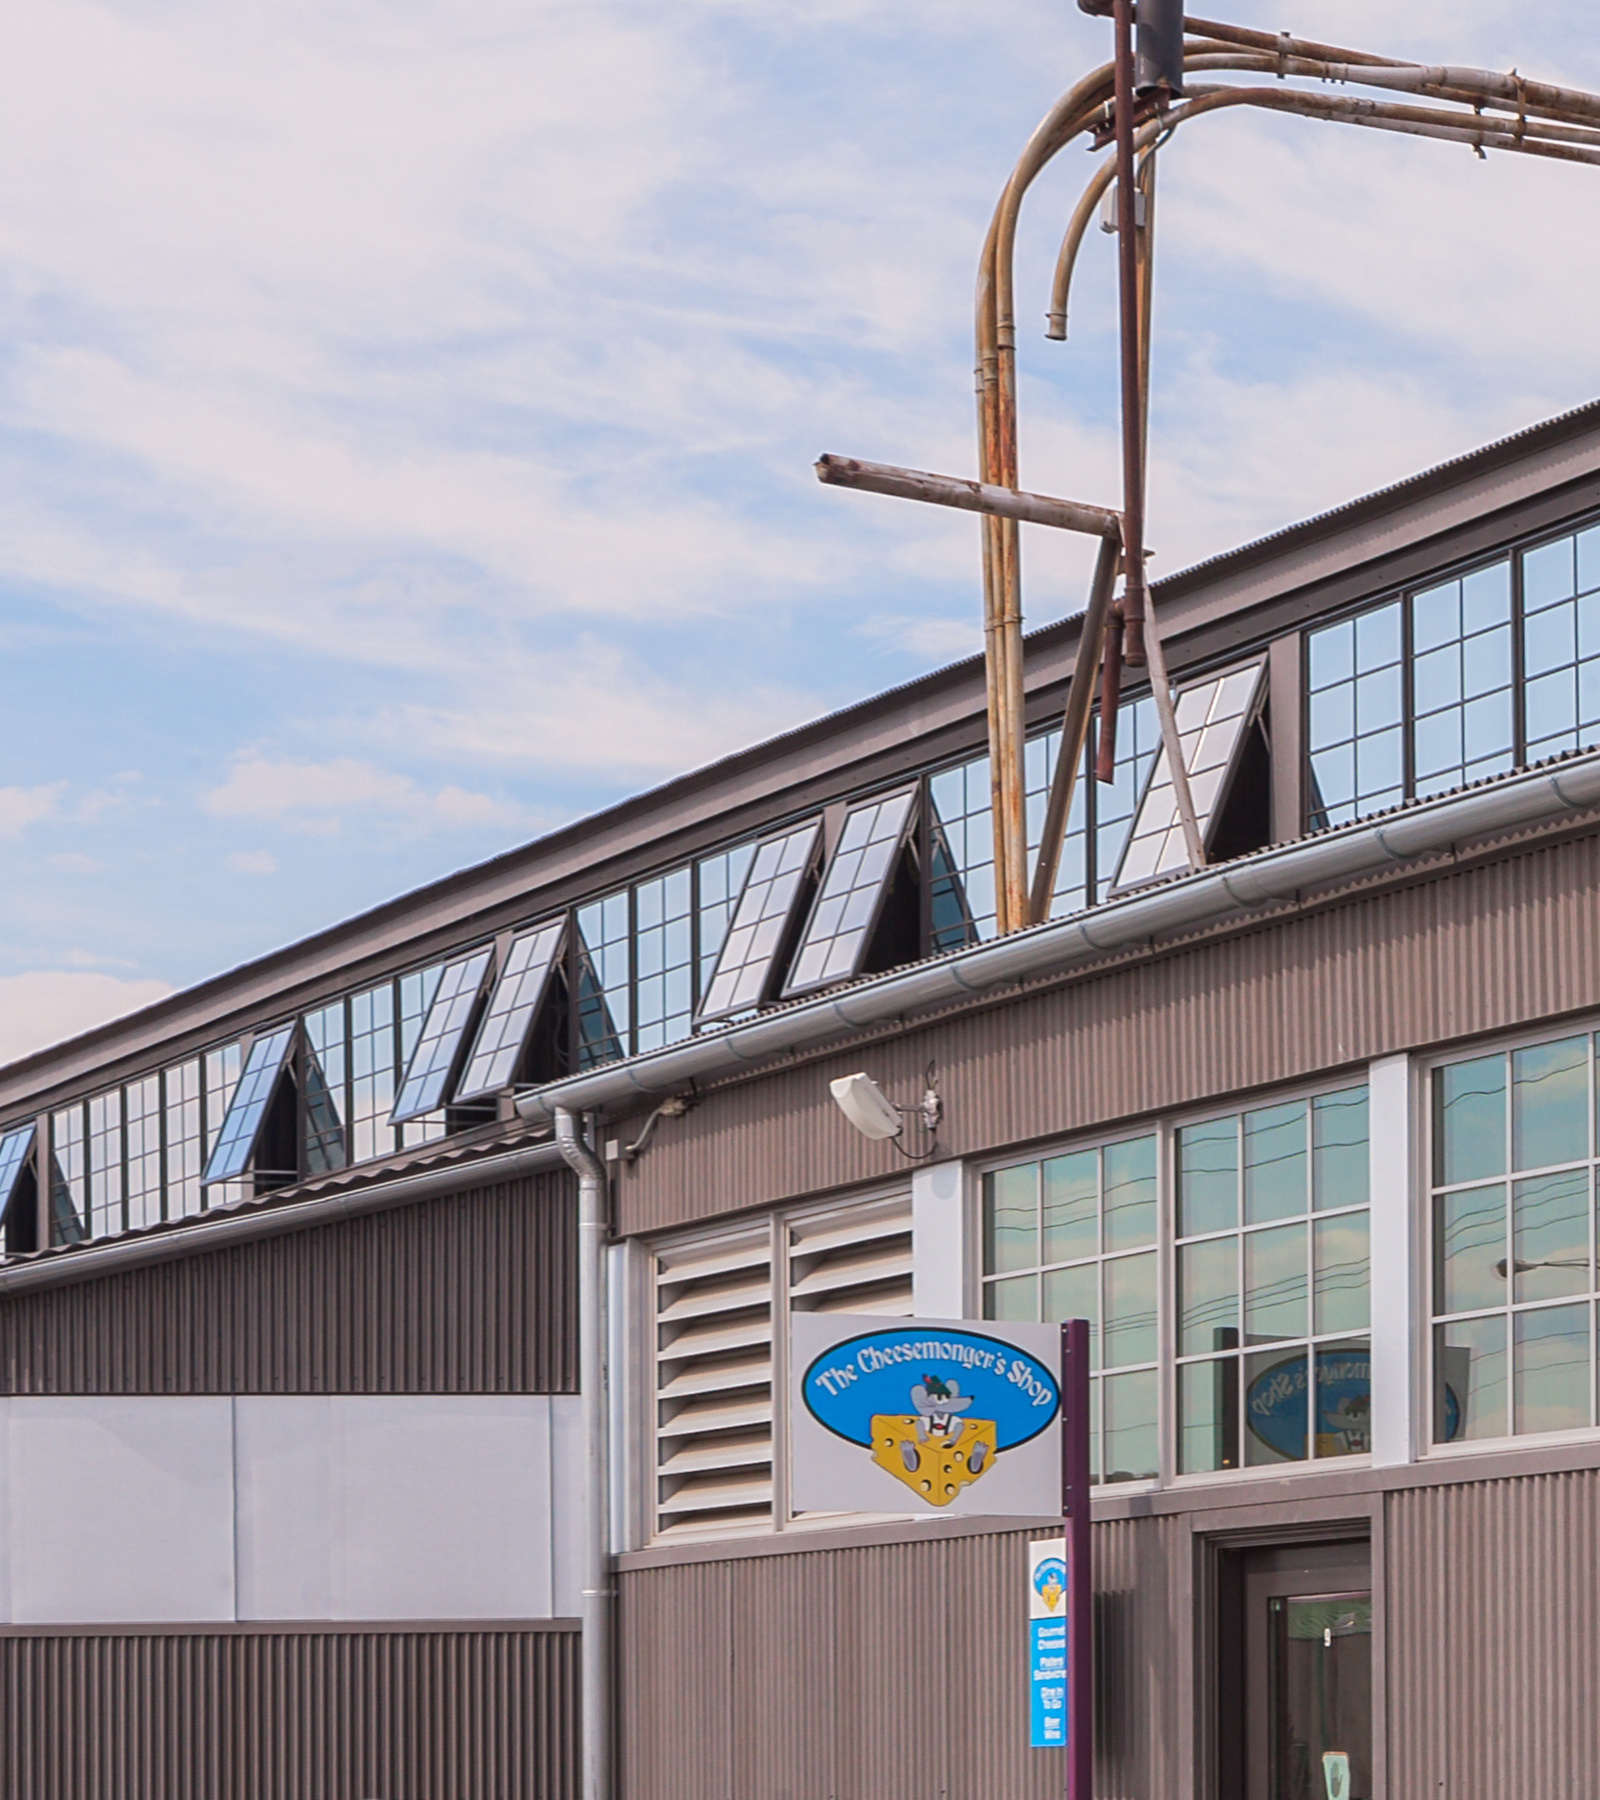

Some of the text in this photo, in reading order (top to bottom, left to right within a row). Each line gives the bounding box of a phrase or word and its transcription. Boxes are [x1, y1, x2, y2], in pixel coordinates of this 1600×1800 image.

[815, 1341, 1052, 1407] The Cheesemonger's Shop
